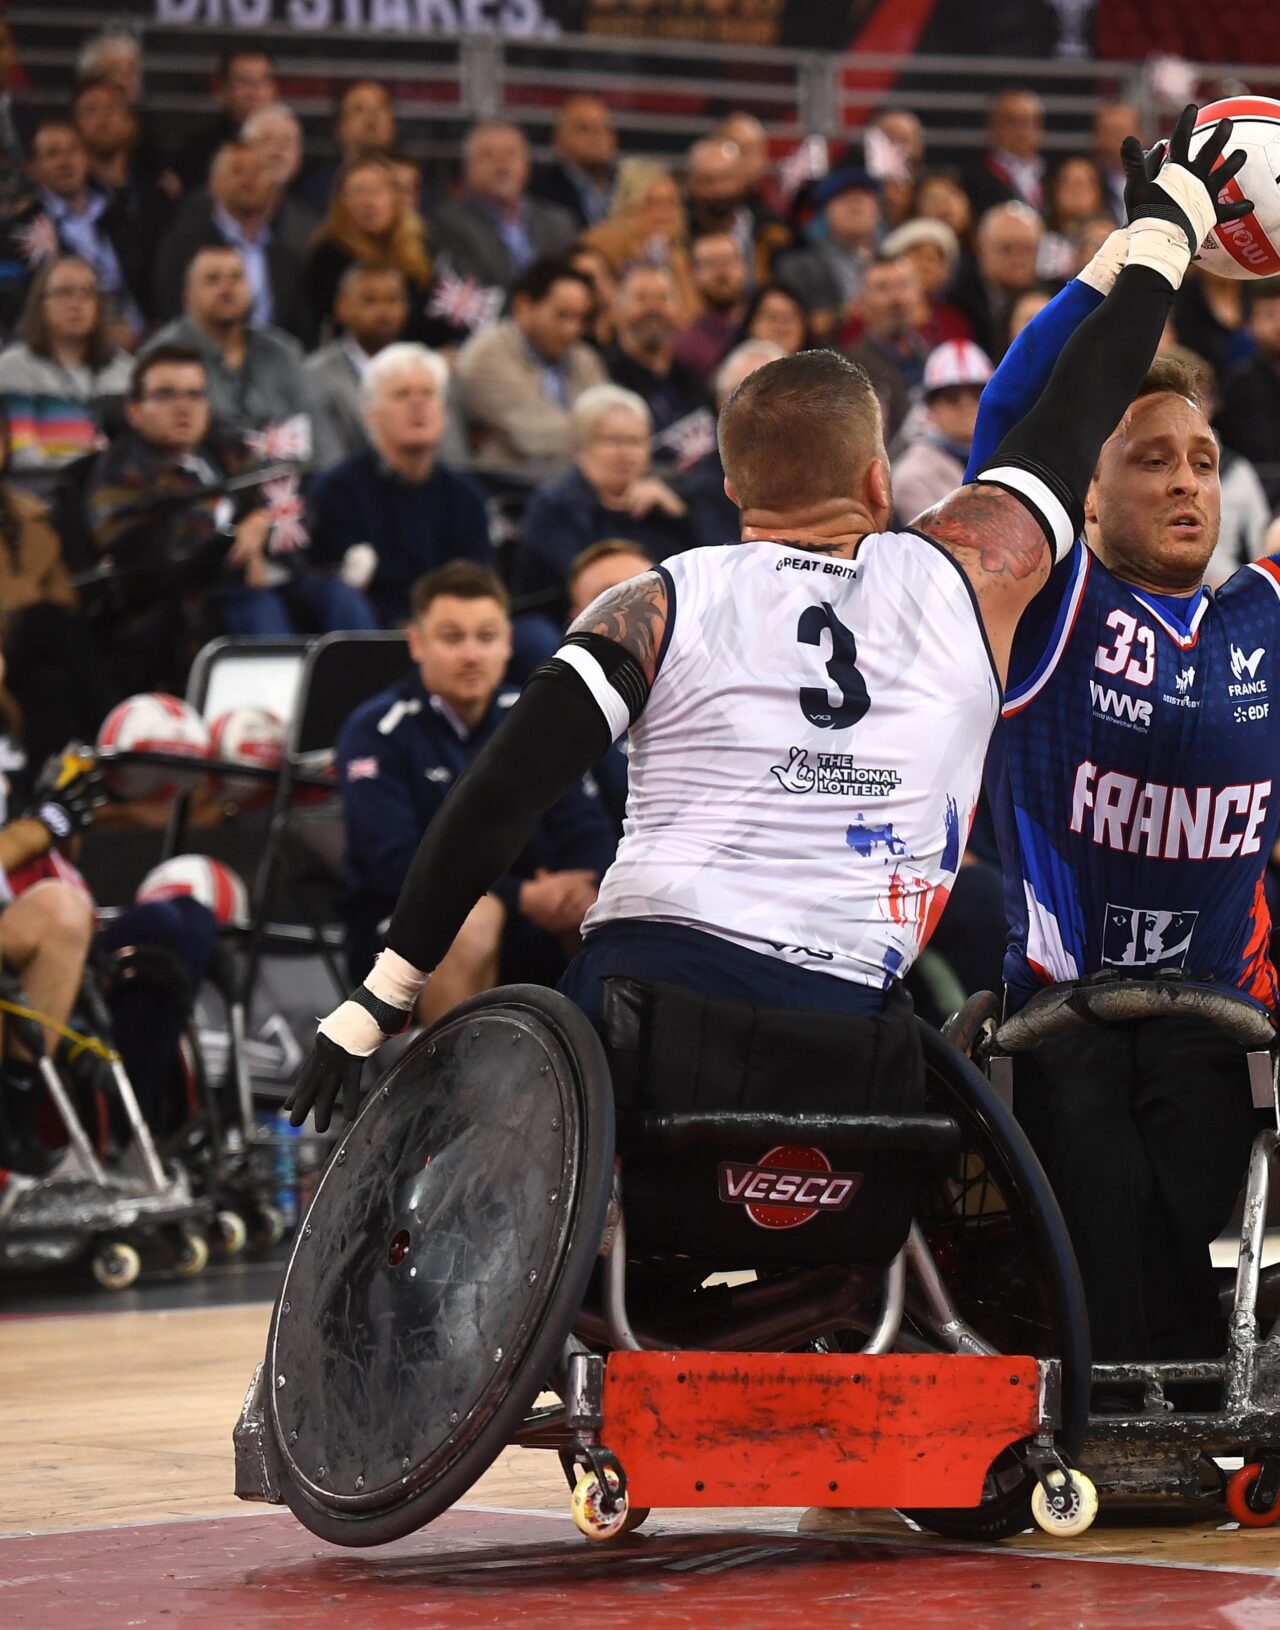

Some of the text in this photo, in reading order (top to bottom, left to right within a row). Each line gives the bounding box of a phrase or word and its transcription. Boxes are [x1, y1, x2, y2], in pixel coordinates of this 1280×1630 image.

[1094, 608, 1156, 687] 33
[797, 601, 871, 730] 3
[1228, 679, 1267, 697] FRANCE
[818, 753, 853, 767] THE
[817, 767, 902, 784] NATIONAL
[817, 780, 895, 796] LOTTERY
[1069, 759, 1272, 859] FRANCE
[725, 1168, 853, 1205] VESCO
